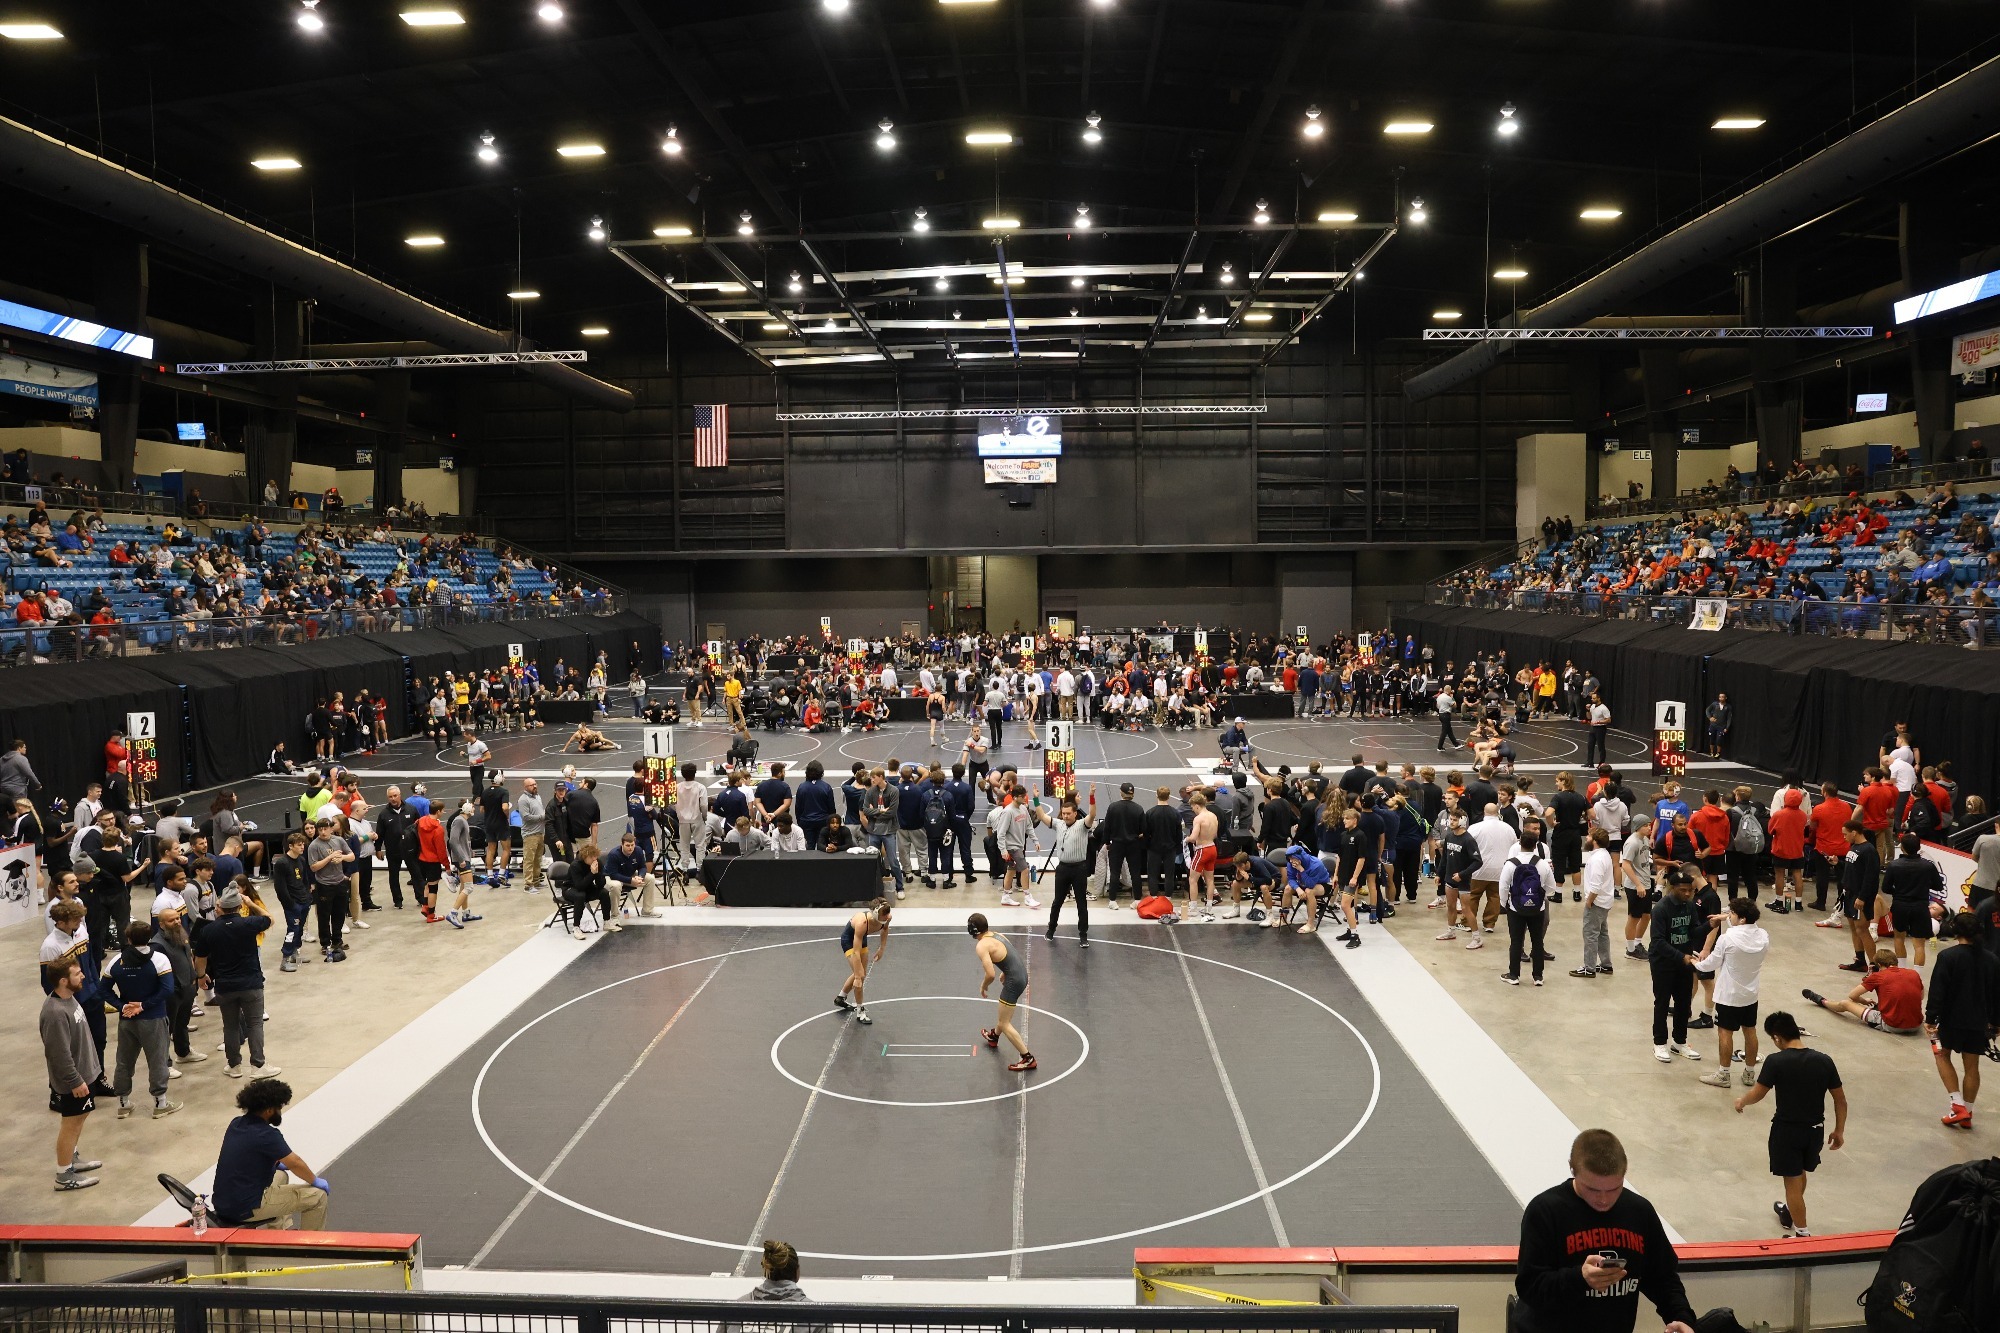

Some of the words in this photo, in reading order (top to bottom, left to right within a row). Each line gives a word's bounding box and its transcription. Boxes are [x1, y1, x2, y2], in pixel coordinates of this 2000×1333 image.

[1962, 350, 1980, 365] egg
[15, 384, 45, 396] PEOPLE
[46, 390, 67, 399] WITH
[68, 394, 97, 404] ENERGY
[1022, 461, 1040, 469] PARK
[28, 490, 40, 500] 113
[1299, 627, 1305, 635] 13
[1025, 638, 1030, 648] 9
[1198, 633, 1203, 643] 7
[1359, 635, 1367, 646] 10
[513, 646, 518, 655] 5
[712, 643, 717, 653] 8
[850, 641, 854, 651] 6
[1664, 706, 1676, 726] 4
[141, 716, 149, 736] 2
[1052, 726, 1060, 747] 3
[1660, 731, 1685, 741] 1008
[135, 739, 155, 750] 1006
[652, 732, 658, 754] 1
[1662, 741, 1668, 751] 0
[1679, 742, 1685, 752] 3
[138, 750, 143, 760] 3
[150, 748, 156, 758] 0
[1050, 762, 1055, 772] 0
[660, 770, 665, 782] 3
[1566, 1227, 1645, 1255] BENEDICTINE
